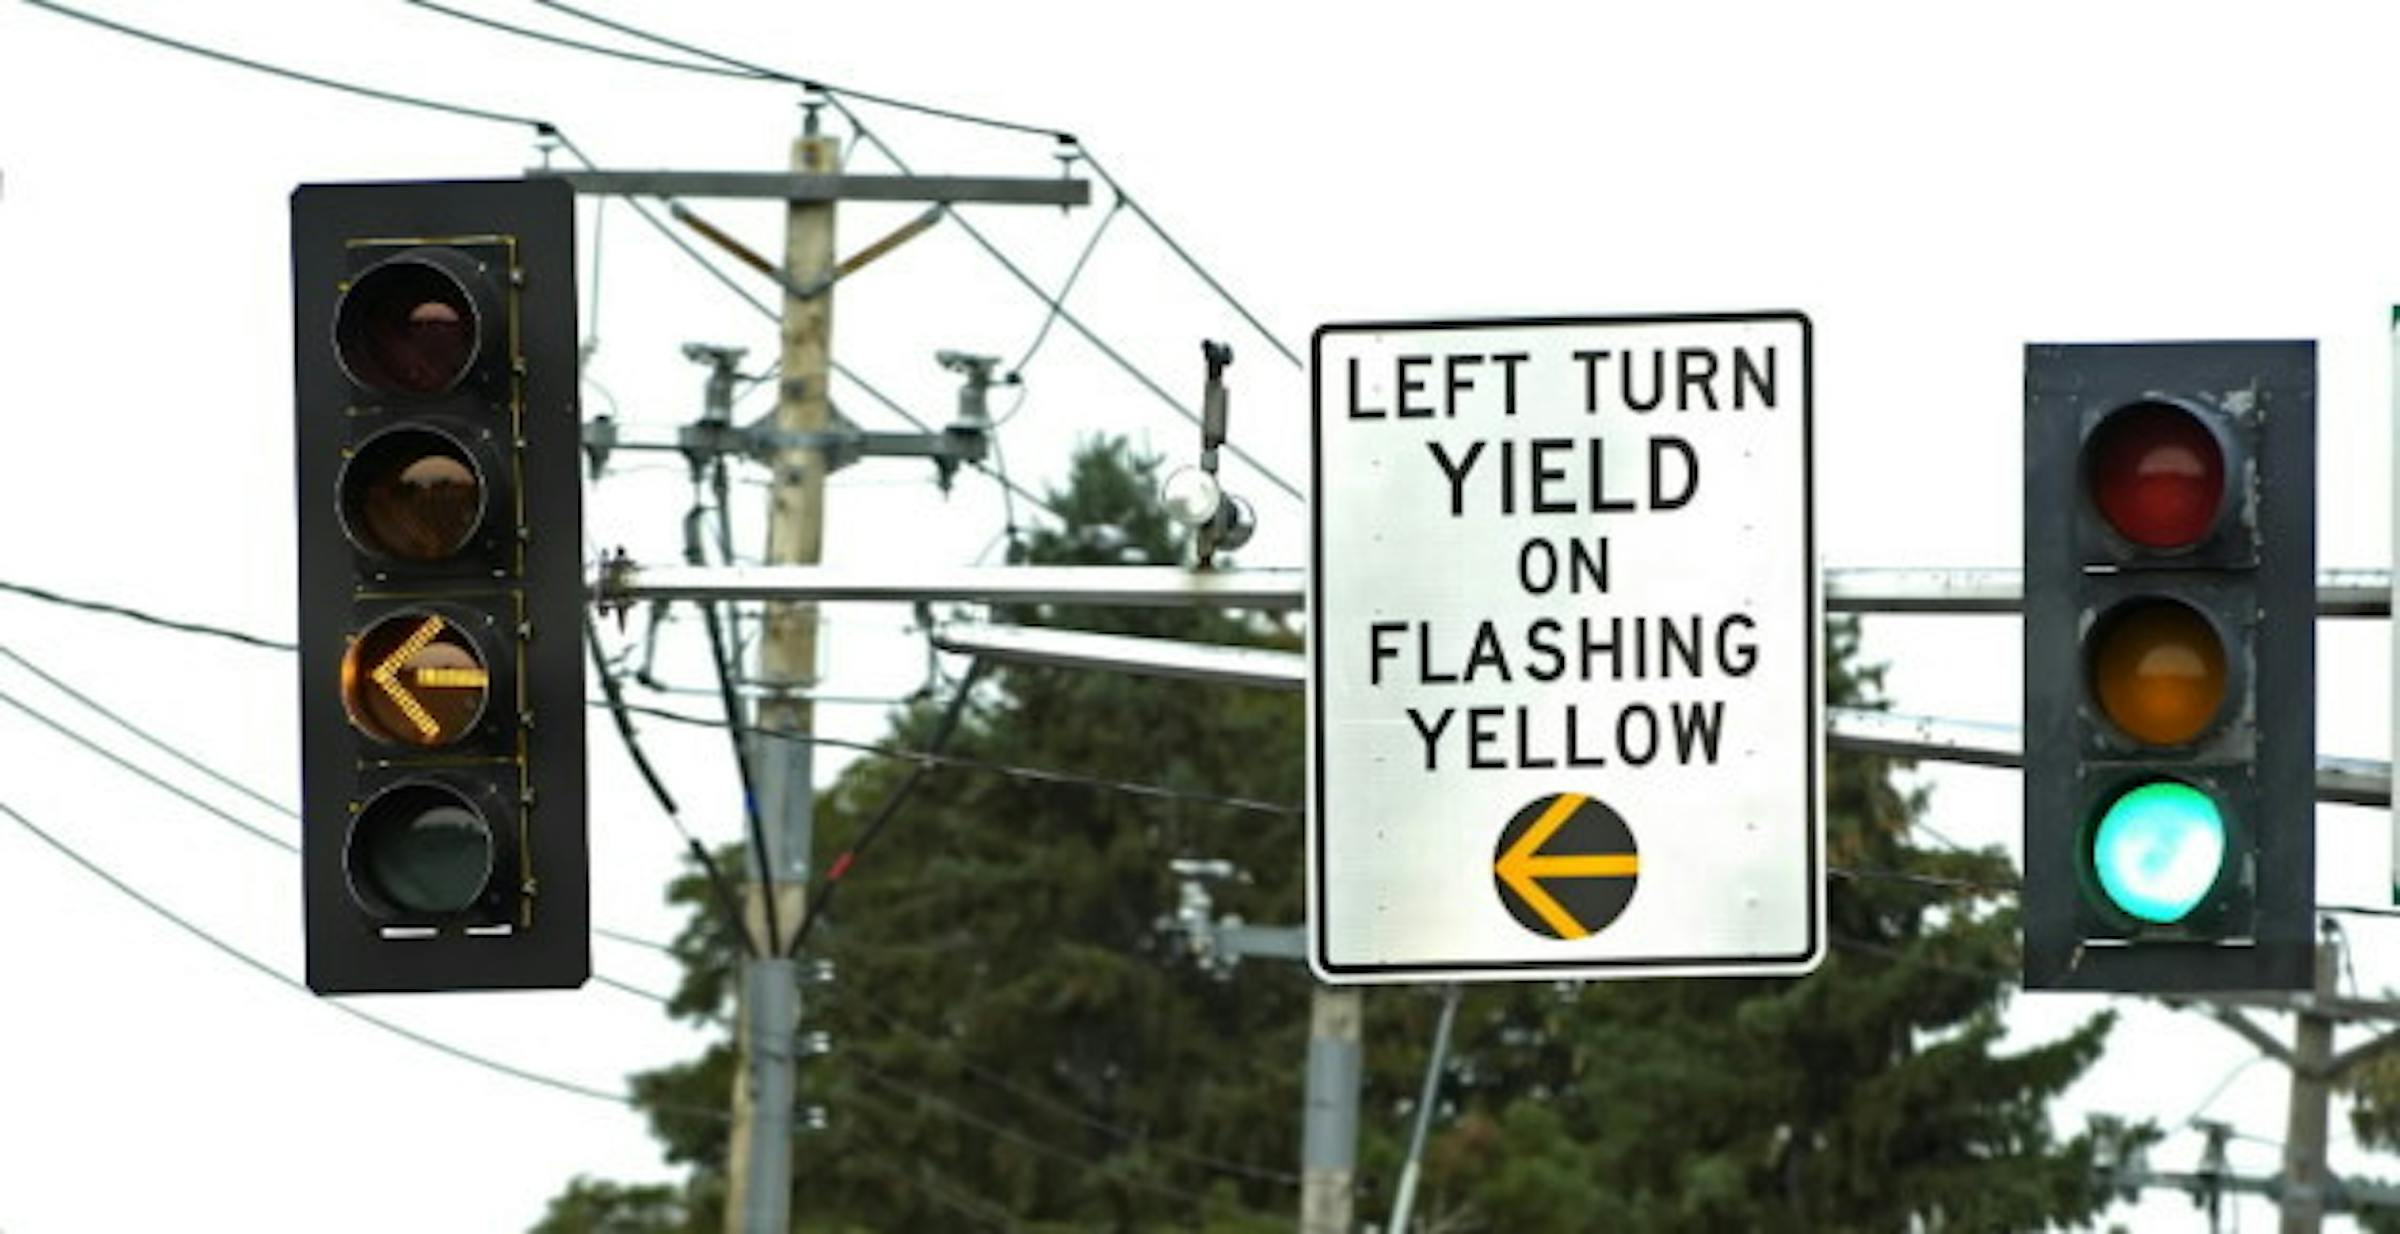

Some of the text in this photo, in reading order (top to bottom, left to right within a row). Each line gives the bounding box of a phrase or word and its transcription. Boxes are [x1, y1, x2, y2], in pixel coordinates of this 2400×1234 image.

[1347, 346, 1778, 420] LEFT TURN
[1427, 436, 1700, 516] YIELD
[1518, 536, 1609, 595] ON
[1370, 613, 1759, 686] FLASHING
[1405, 701, 1725, 772] YELLOW
